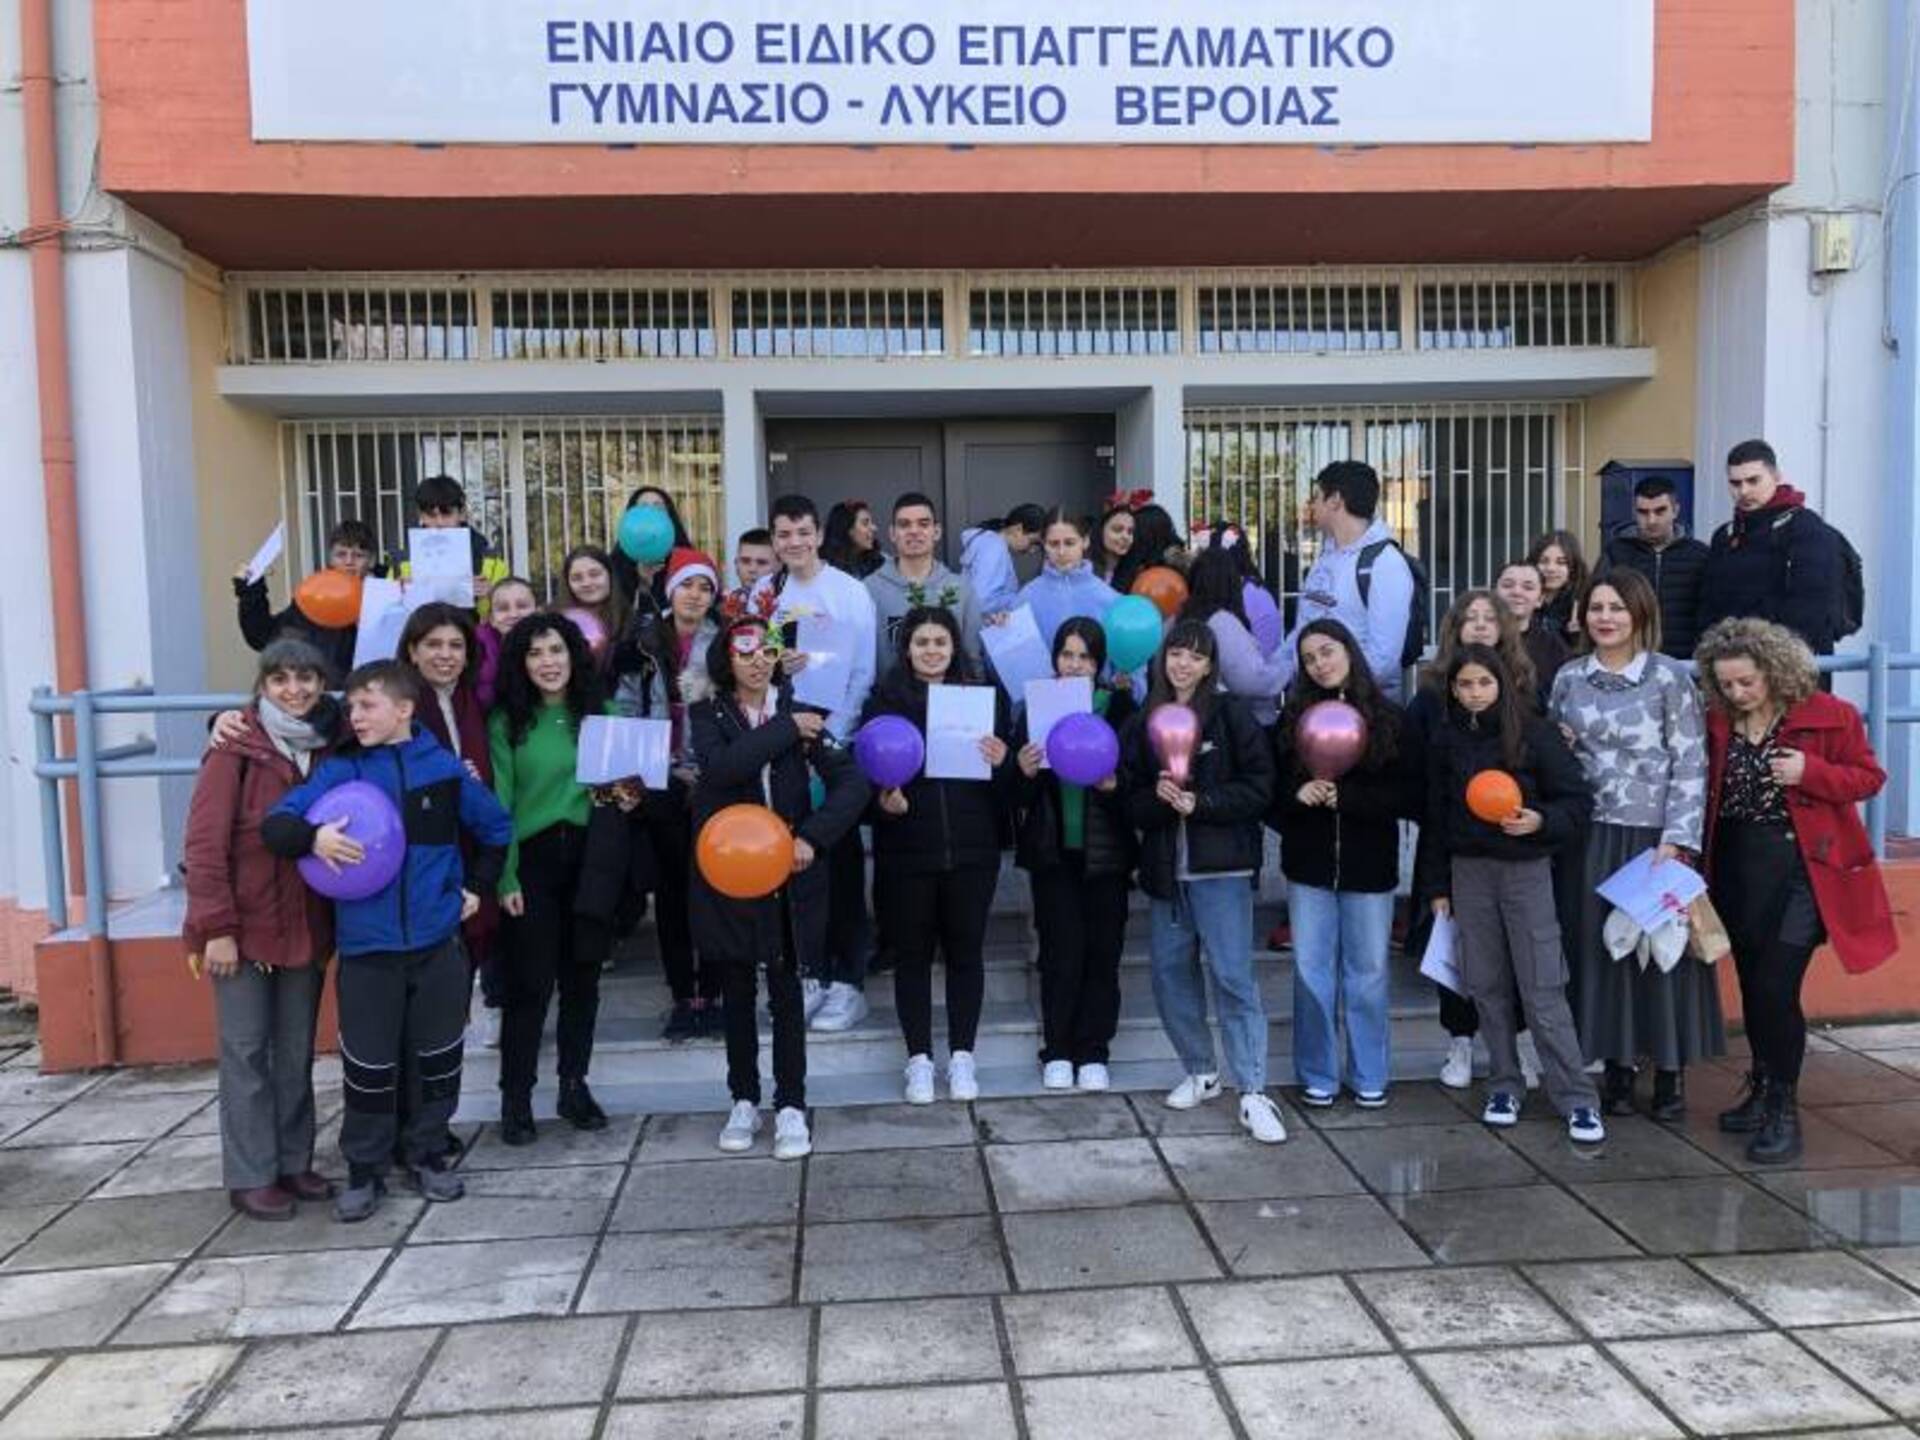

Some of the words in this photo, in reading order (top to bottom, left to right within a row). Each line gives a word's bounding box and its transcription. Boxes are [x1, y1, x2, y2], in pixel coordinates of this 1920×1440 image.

[547, 21, 734, 64] ΕΝΙΑΙΟ
[756, 23, 936, 65] ΕΙΔΙΚΟ
[959, 25, 1394, 68] ΕΠΑΓΓΕΛΜΑΤΙΚΟ
[550, 82, 829, 125] ΓΥΜΝΑΣΙΟ
[880, 84, 1066, 127] ΛΥΚΕΙΟ
[1116, 85, 1340, 126] ΒΕΡΟΙΑΣ
